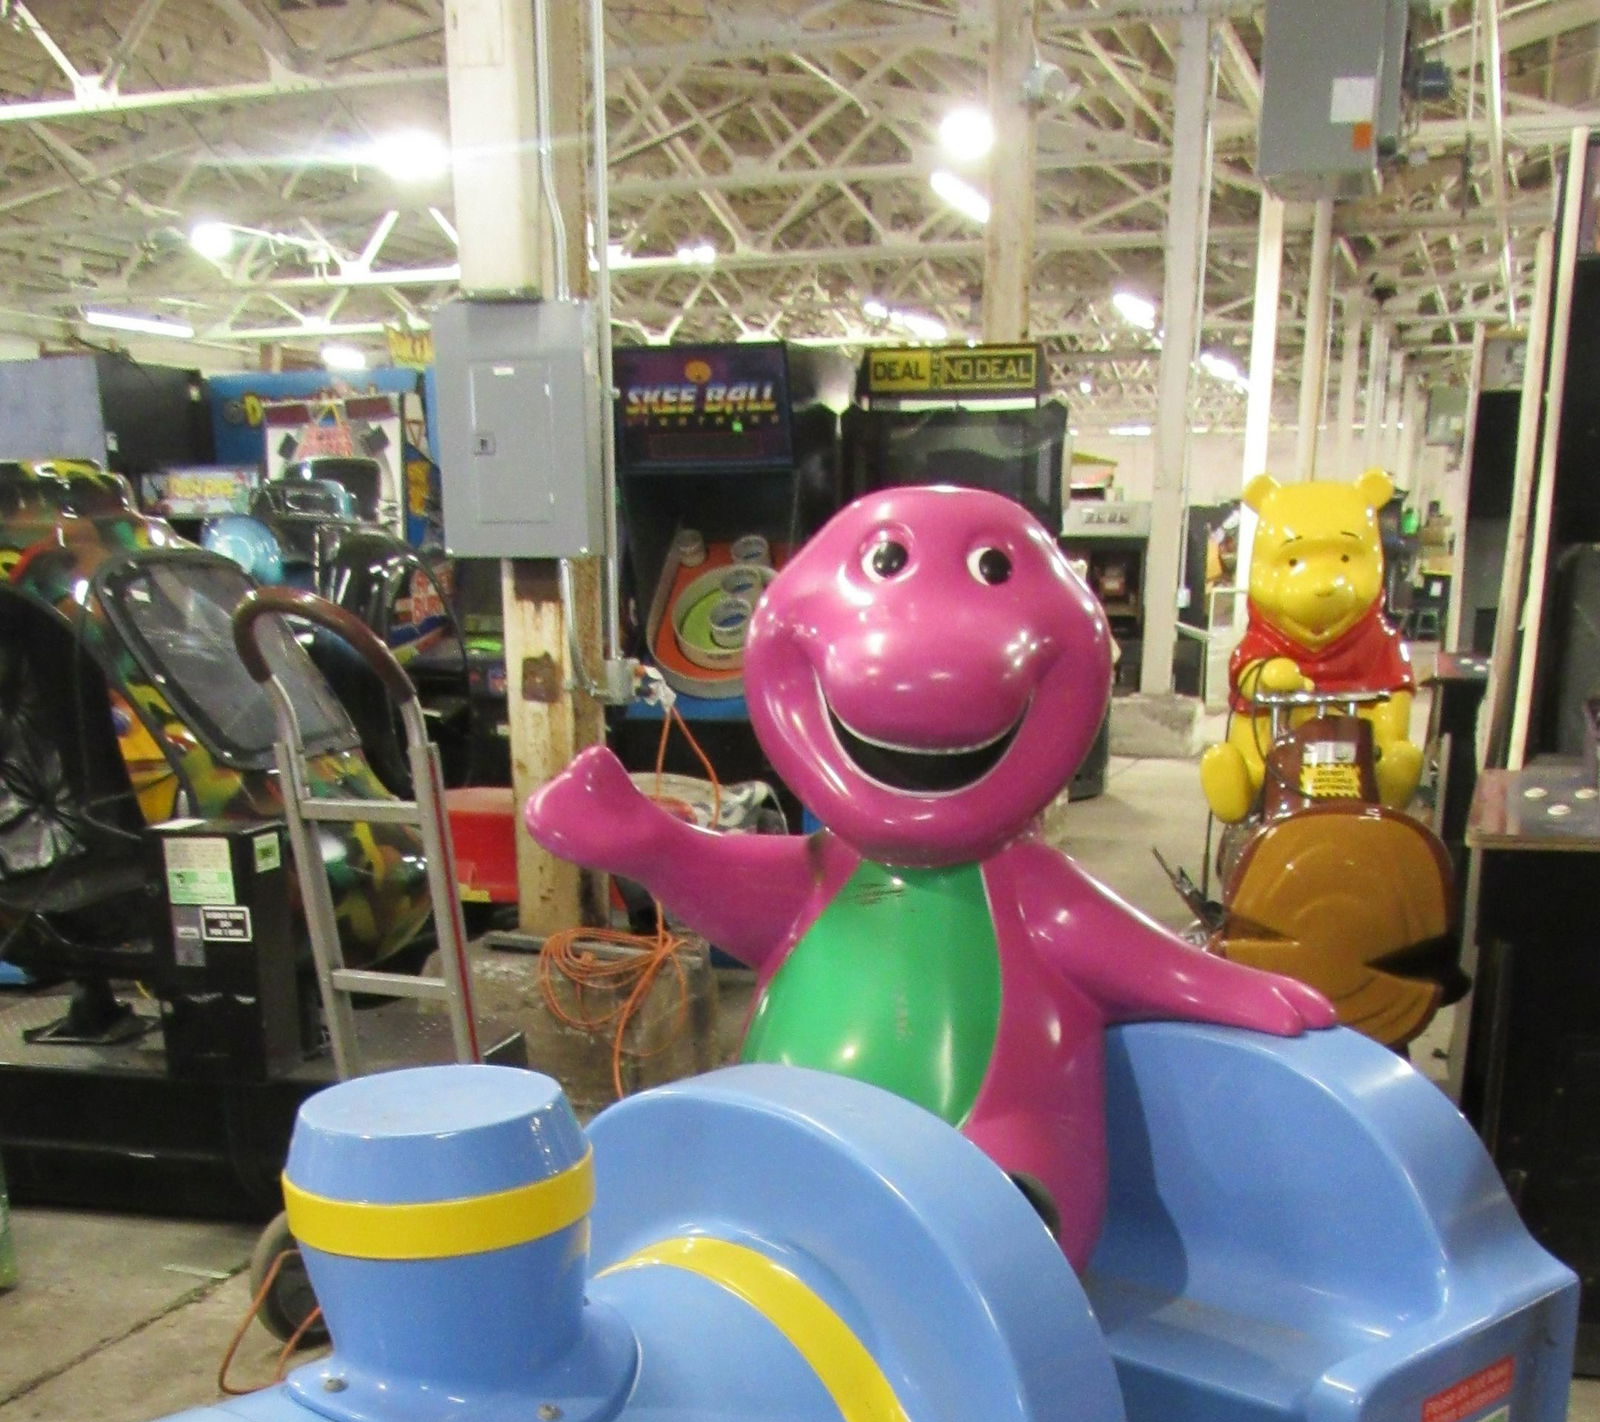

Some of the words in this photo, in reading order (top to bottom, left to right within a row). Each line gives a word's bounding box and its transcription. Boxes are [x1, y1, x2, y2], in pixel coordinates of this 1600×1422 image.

[873, 360, 925, 381] DEAL
[944, 357, 973, 383] NO
[976, 355, 1032, 380] DEAL
[625, 384, 697, 414] SKEE
[704, 382, 777, 413] BALL
